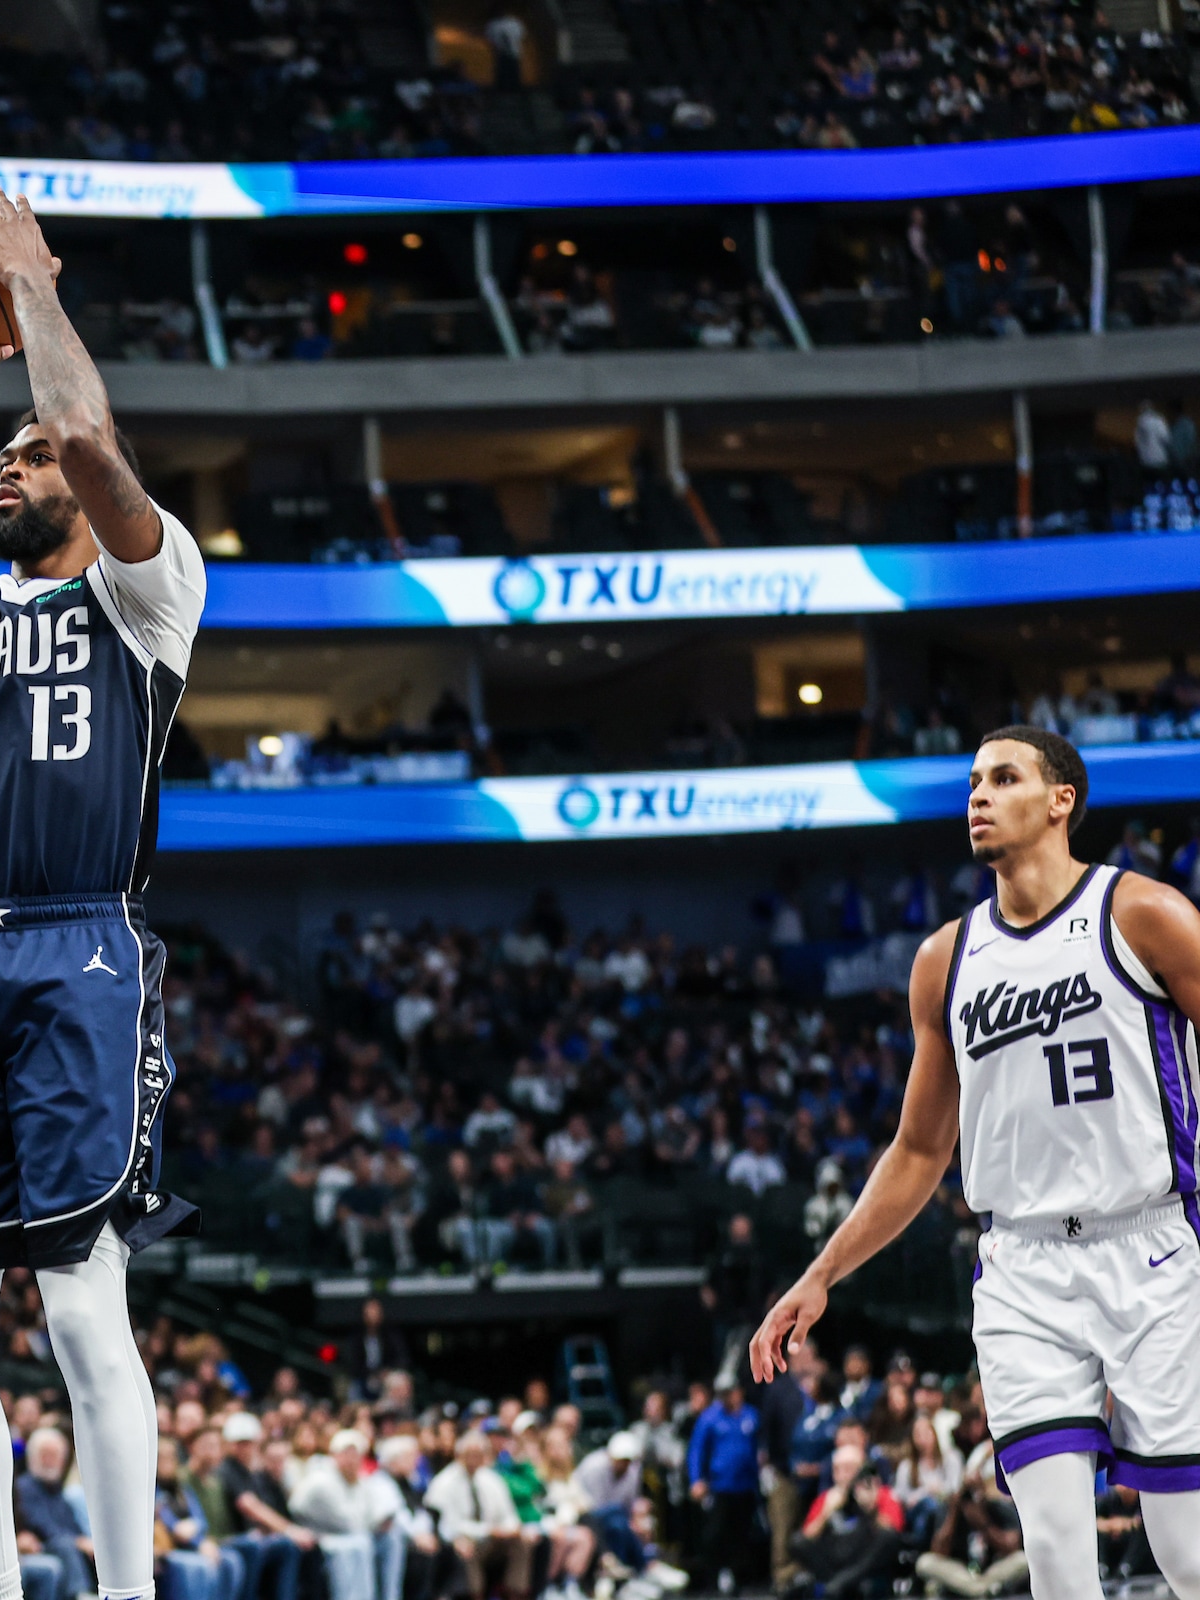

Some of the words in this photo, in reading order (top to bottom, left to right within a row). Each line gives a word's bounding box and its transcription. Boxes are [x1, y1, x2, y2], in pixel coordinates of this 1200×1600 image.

[28, 684, 92, 761] 13
[959, 971, 1103, 1061] Kings
[1042, 1036, 1115, 1107] 13
